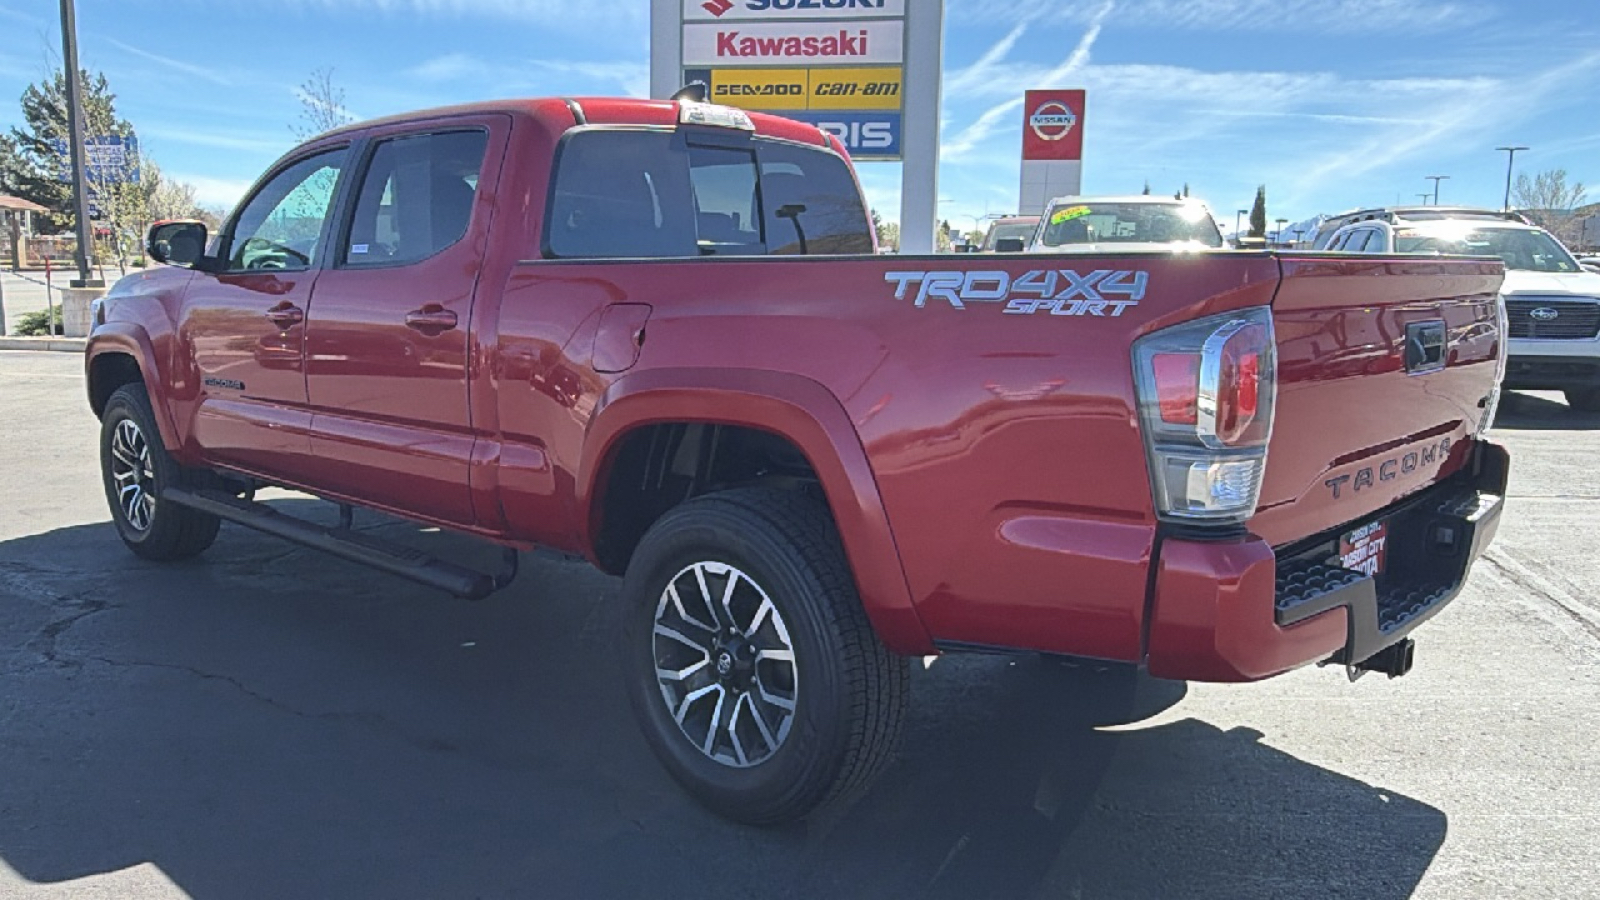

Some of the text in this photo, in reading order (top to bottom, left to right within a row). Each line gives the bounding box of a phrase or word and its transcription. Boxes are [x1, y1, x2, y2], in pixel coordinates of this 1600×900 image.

[716, 30, 868, 57] Kawasaki
[1033, 116, 1072, 125] NISSAN
[816, 121, 893, 148] RIS
[1002, 298, 1138, 317] SPORT
[1325, 437, 1451, 499] TACOMA
